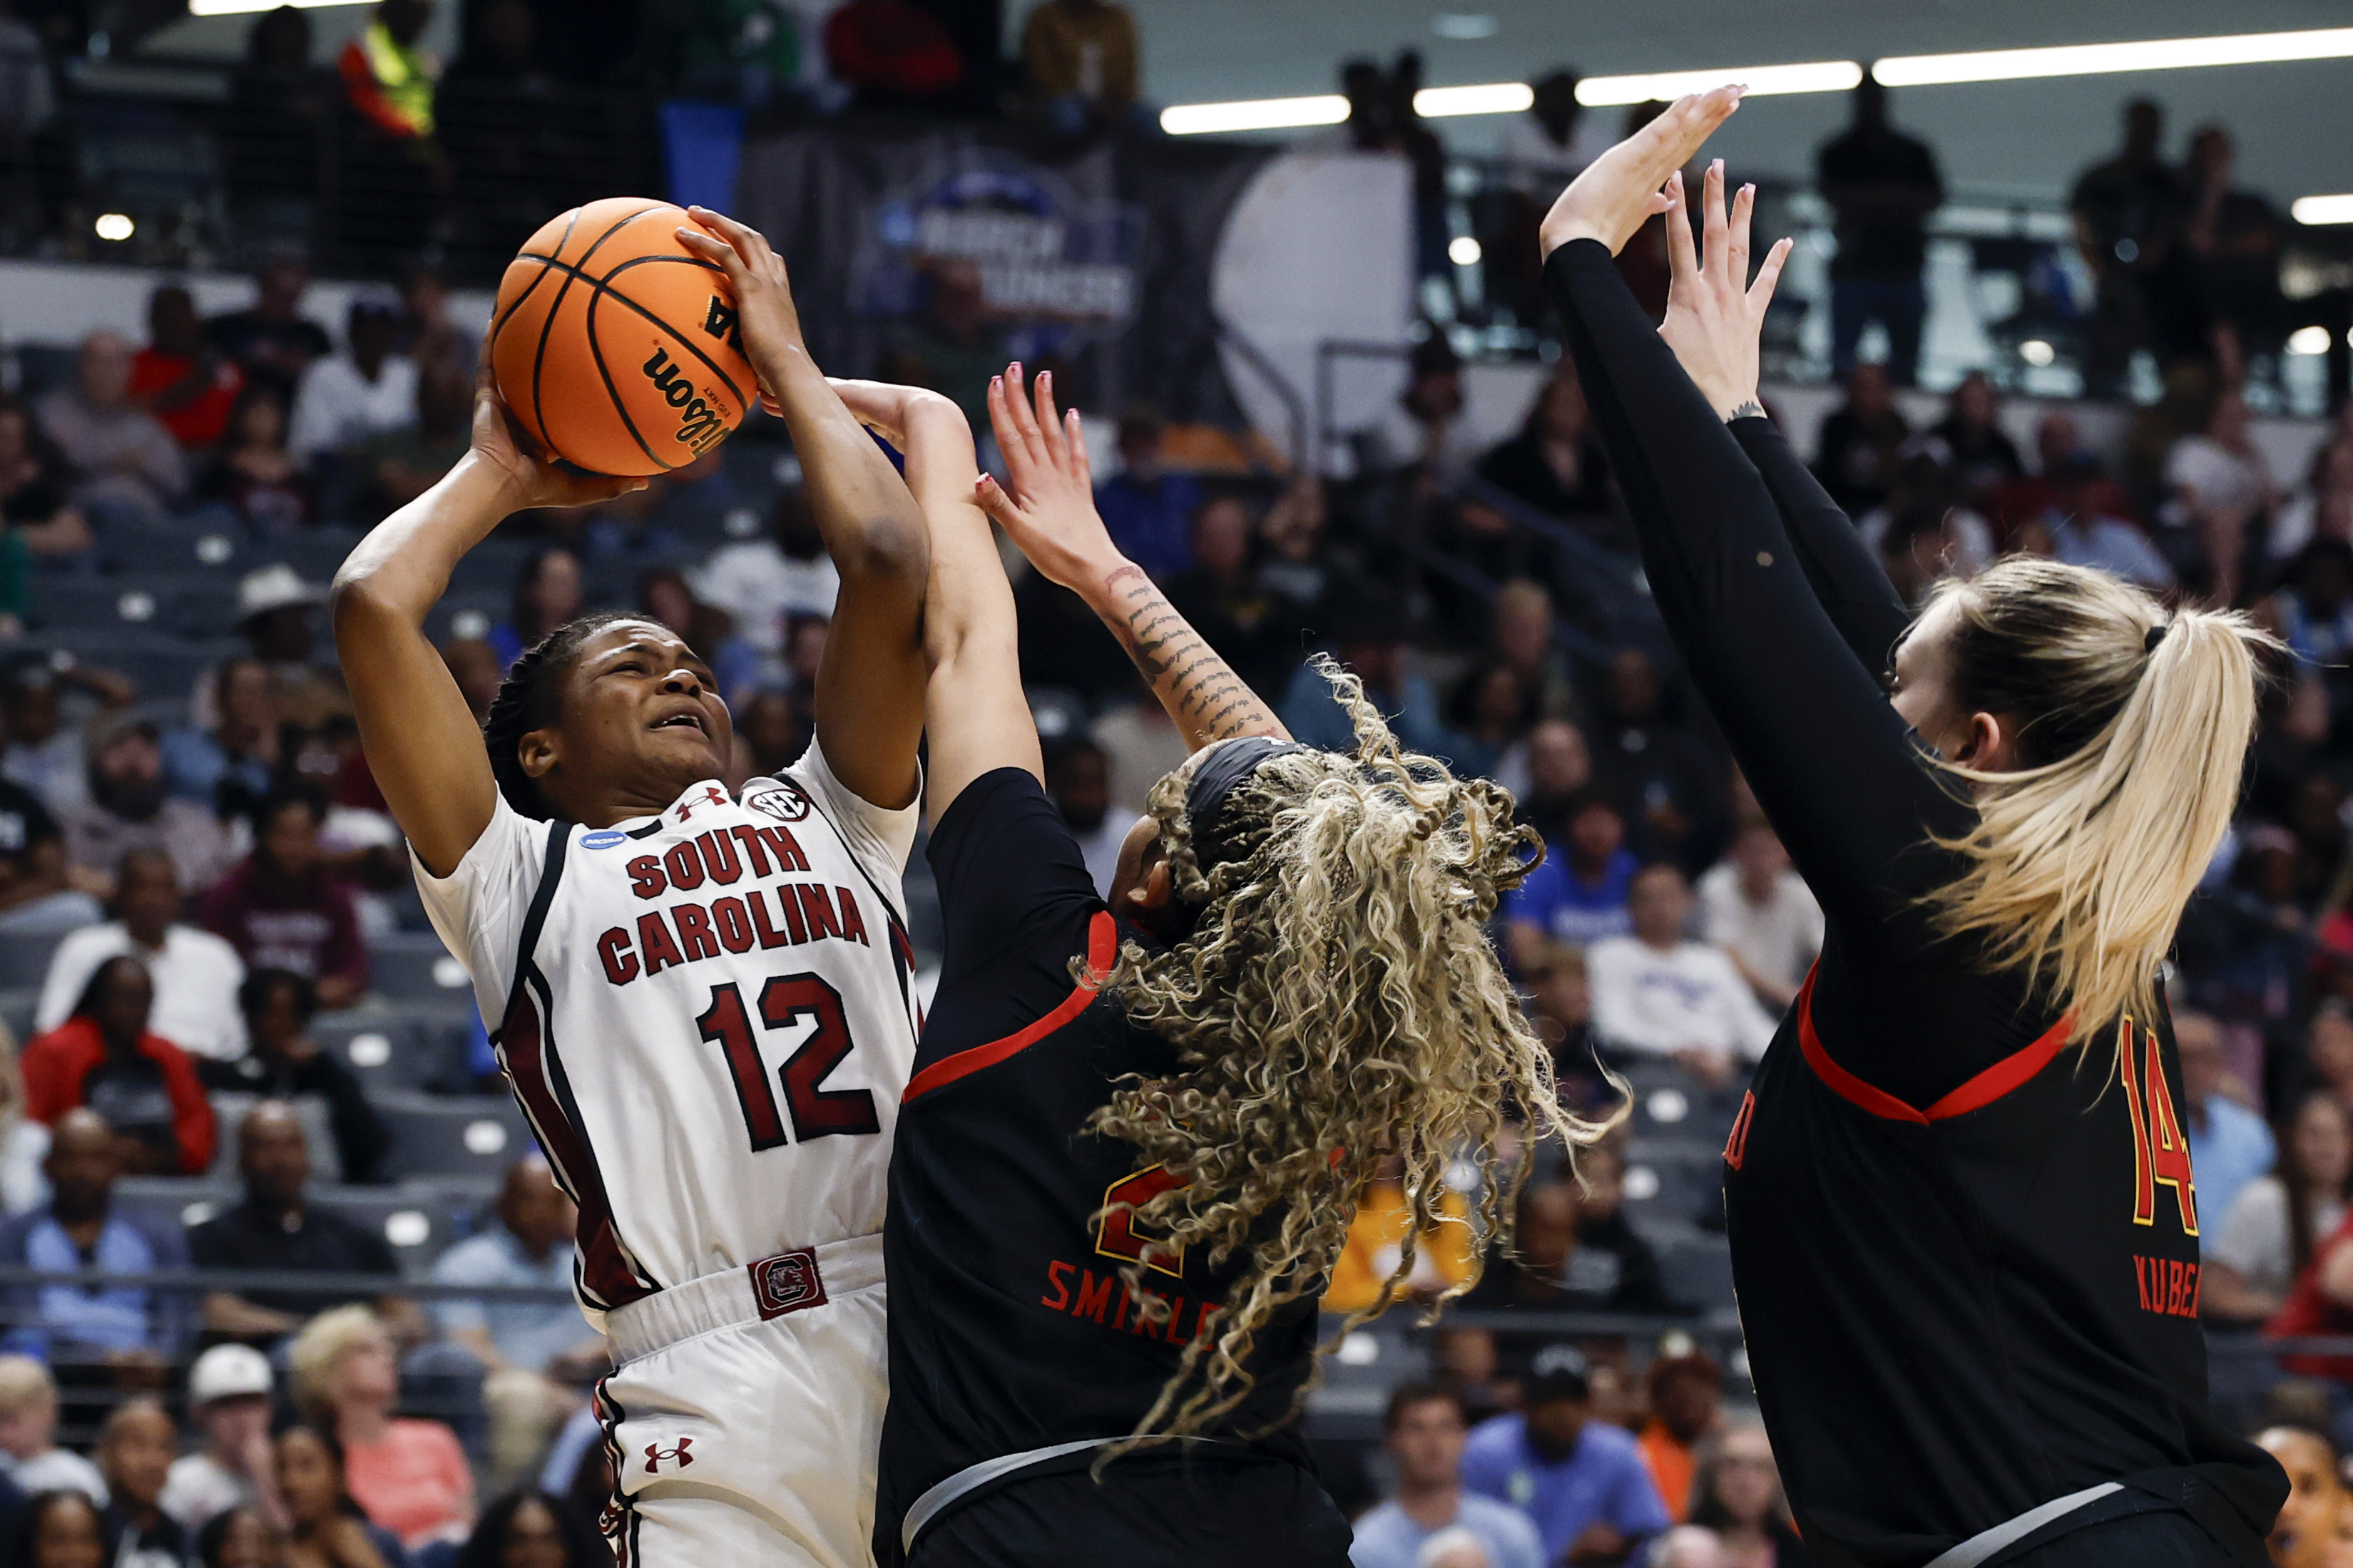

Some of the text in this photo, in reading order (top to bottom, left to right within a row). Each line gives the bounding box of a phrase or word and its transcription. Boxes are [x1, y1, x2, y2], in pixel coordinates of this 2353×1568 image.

[752, 791, 805, 819] SEC
[626, 824, 811, 900] SOUTH
[597, 883, 870, 986] CAROLINA
[695, 971, 881, 1153] 12
[2120, 1014, 2199, 1236] 14
